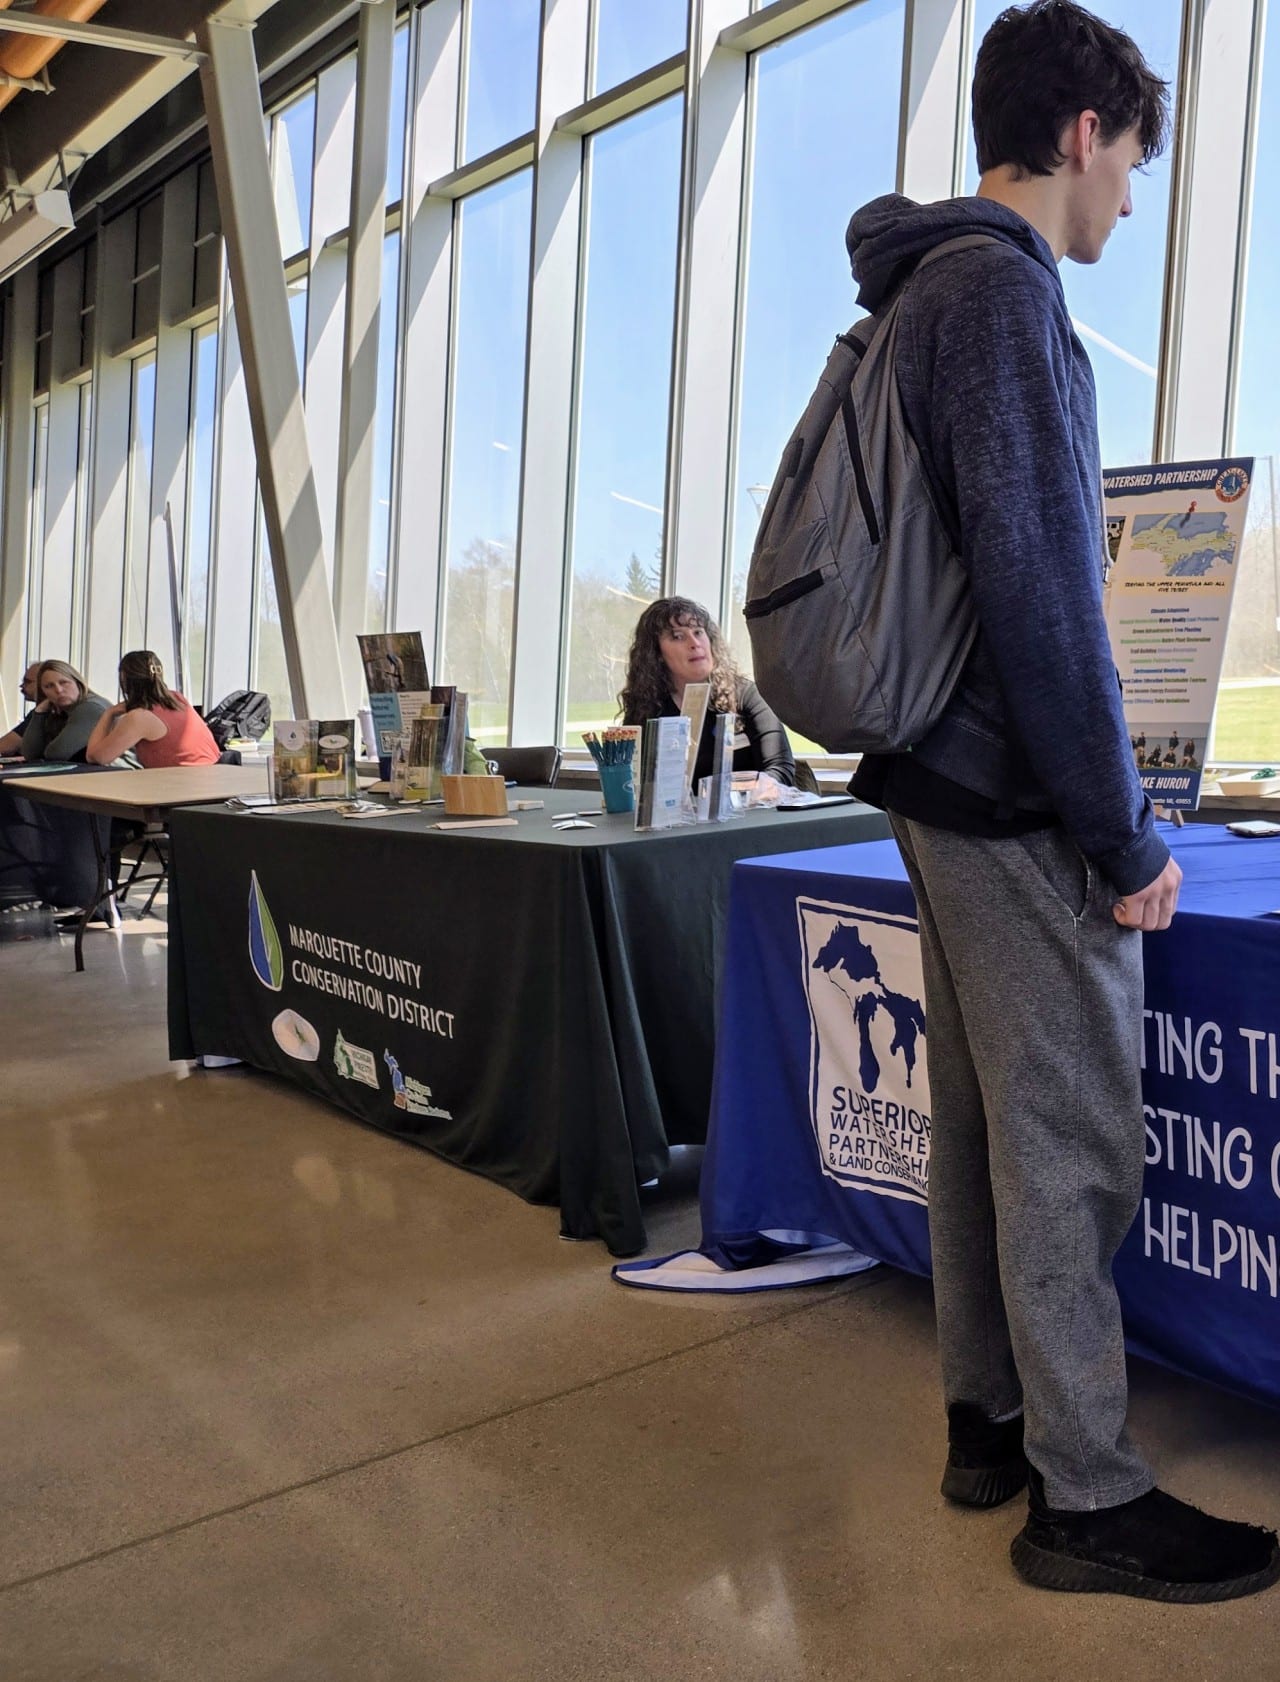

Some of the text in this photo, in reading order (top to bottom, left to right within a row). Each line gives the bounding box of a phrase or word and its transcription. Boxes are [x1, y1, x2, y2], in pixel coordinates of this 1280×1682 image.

[1103, 468, 1218, 489] WATERSHED PARTNERSHIP
[1140, 776, 1190, 789] KE HURON
[289, 922, 421, 989] MARQUETTE COUNTY
[292, 959, 454, 1039] CONSERVATION DISTRICT
[1141, 1009, 1223, 1084] TING
[830, 1112, 928, 1155] WATERSHE
[831, 1086, 931, 1138] SUPERIOR
[829, 1133, 928, 1178] PARTNERSHI
[830, 1152, 837, 1165] &
[839, 1154, 873, 1171] LAND
[1142, 1104, 1253, 1190] STING
